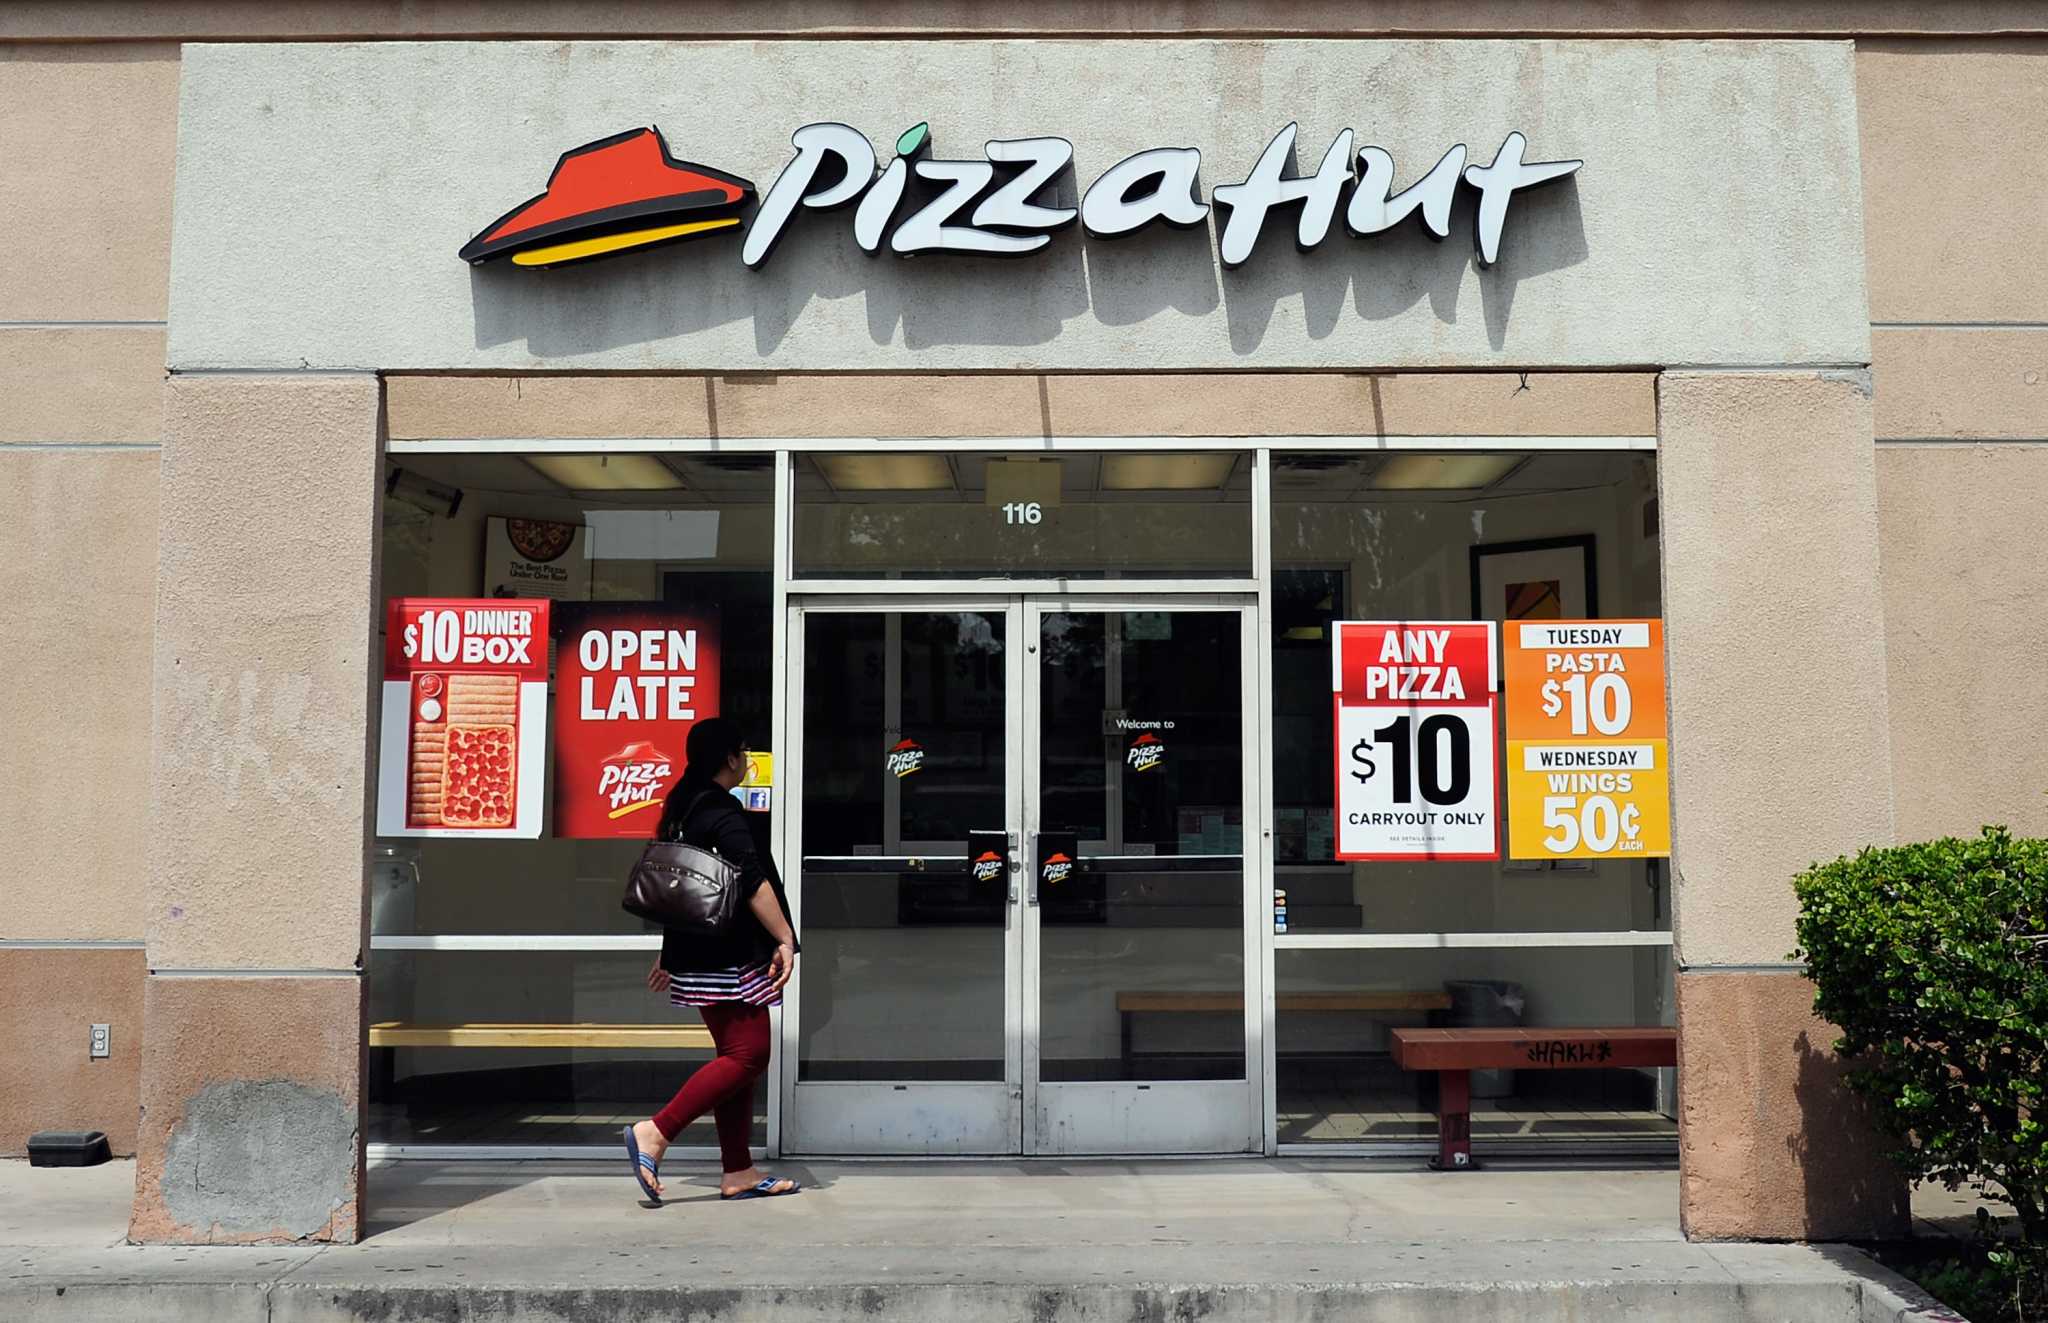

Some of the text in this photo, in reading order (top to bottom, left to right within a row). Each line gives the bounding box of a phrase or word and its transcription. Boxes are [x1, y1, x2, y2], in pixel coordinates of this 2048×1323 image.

[741, 121, 1584, 271] Pizza Hut
[1002, 502, 1042, 524] 116
[403, 610, 532, 663] $10 DINNER
[1379, 630, 1451, 663] ANY
[1547, 629, 1622, 645] TUESDAY
[462, 637, 531, 663] BOX
[579, 630, 697, 671] OPEN
[1546, 653, 1626, 673] PASTA
[1366, 666, 1466, 700] PIZZA
[580, 676, 695, 720] LATE
[1541, 672, 1632, 736] $10
[1115, 719, 1175, 729] Welcome to
[887, 750, 924, 770] Pizza
[1127, 744, 1164, 764] Pizza
[1134, 753, 1160, 768] Hut
[1351, 714, 1470, 806] $10
[1540, 751, 1638, 766] WEDNESDAY
[599, 760, 671, 795] Pizza
[894, 760, 921, 775] Hut
[1547, 773, 1633, 793] WINGS
[609, 780, 663, 809] Hut
[1349, 813, 1485, 825] CARRYOUT ONLY
[1543, 795, 1641, 853] 50¢
[1618, 841, 1643, 851] EACH
[973, 861, 1003, 875] Pizza
[978, 869, 1000, 879] Hut
[1043, 863, 1073, 877] Pizza
[1048, 870, 1068, 881] Hut
